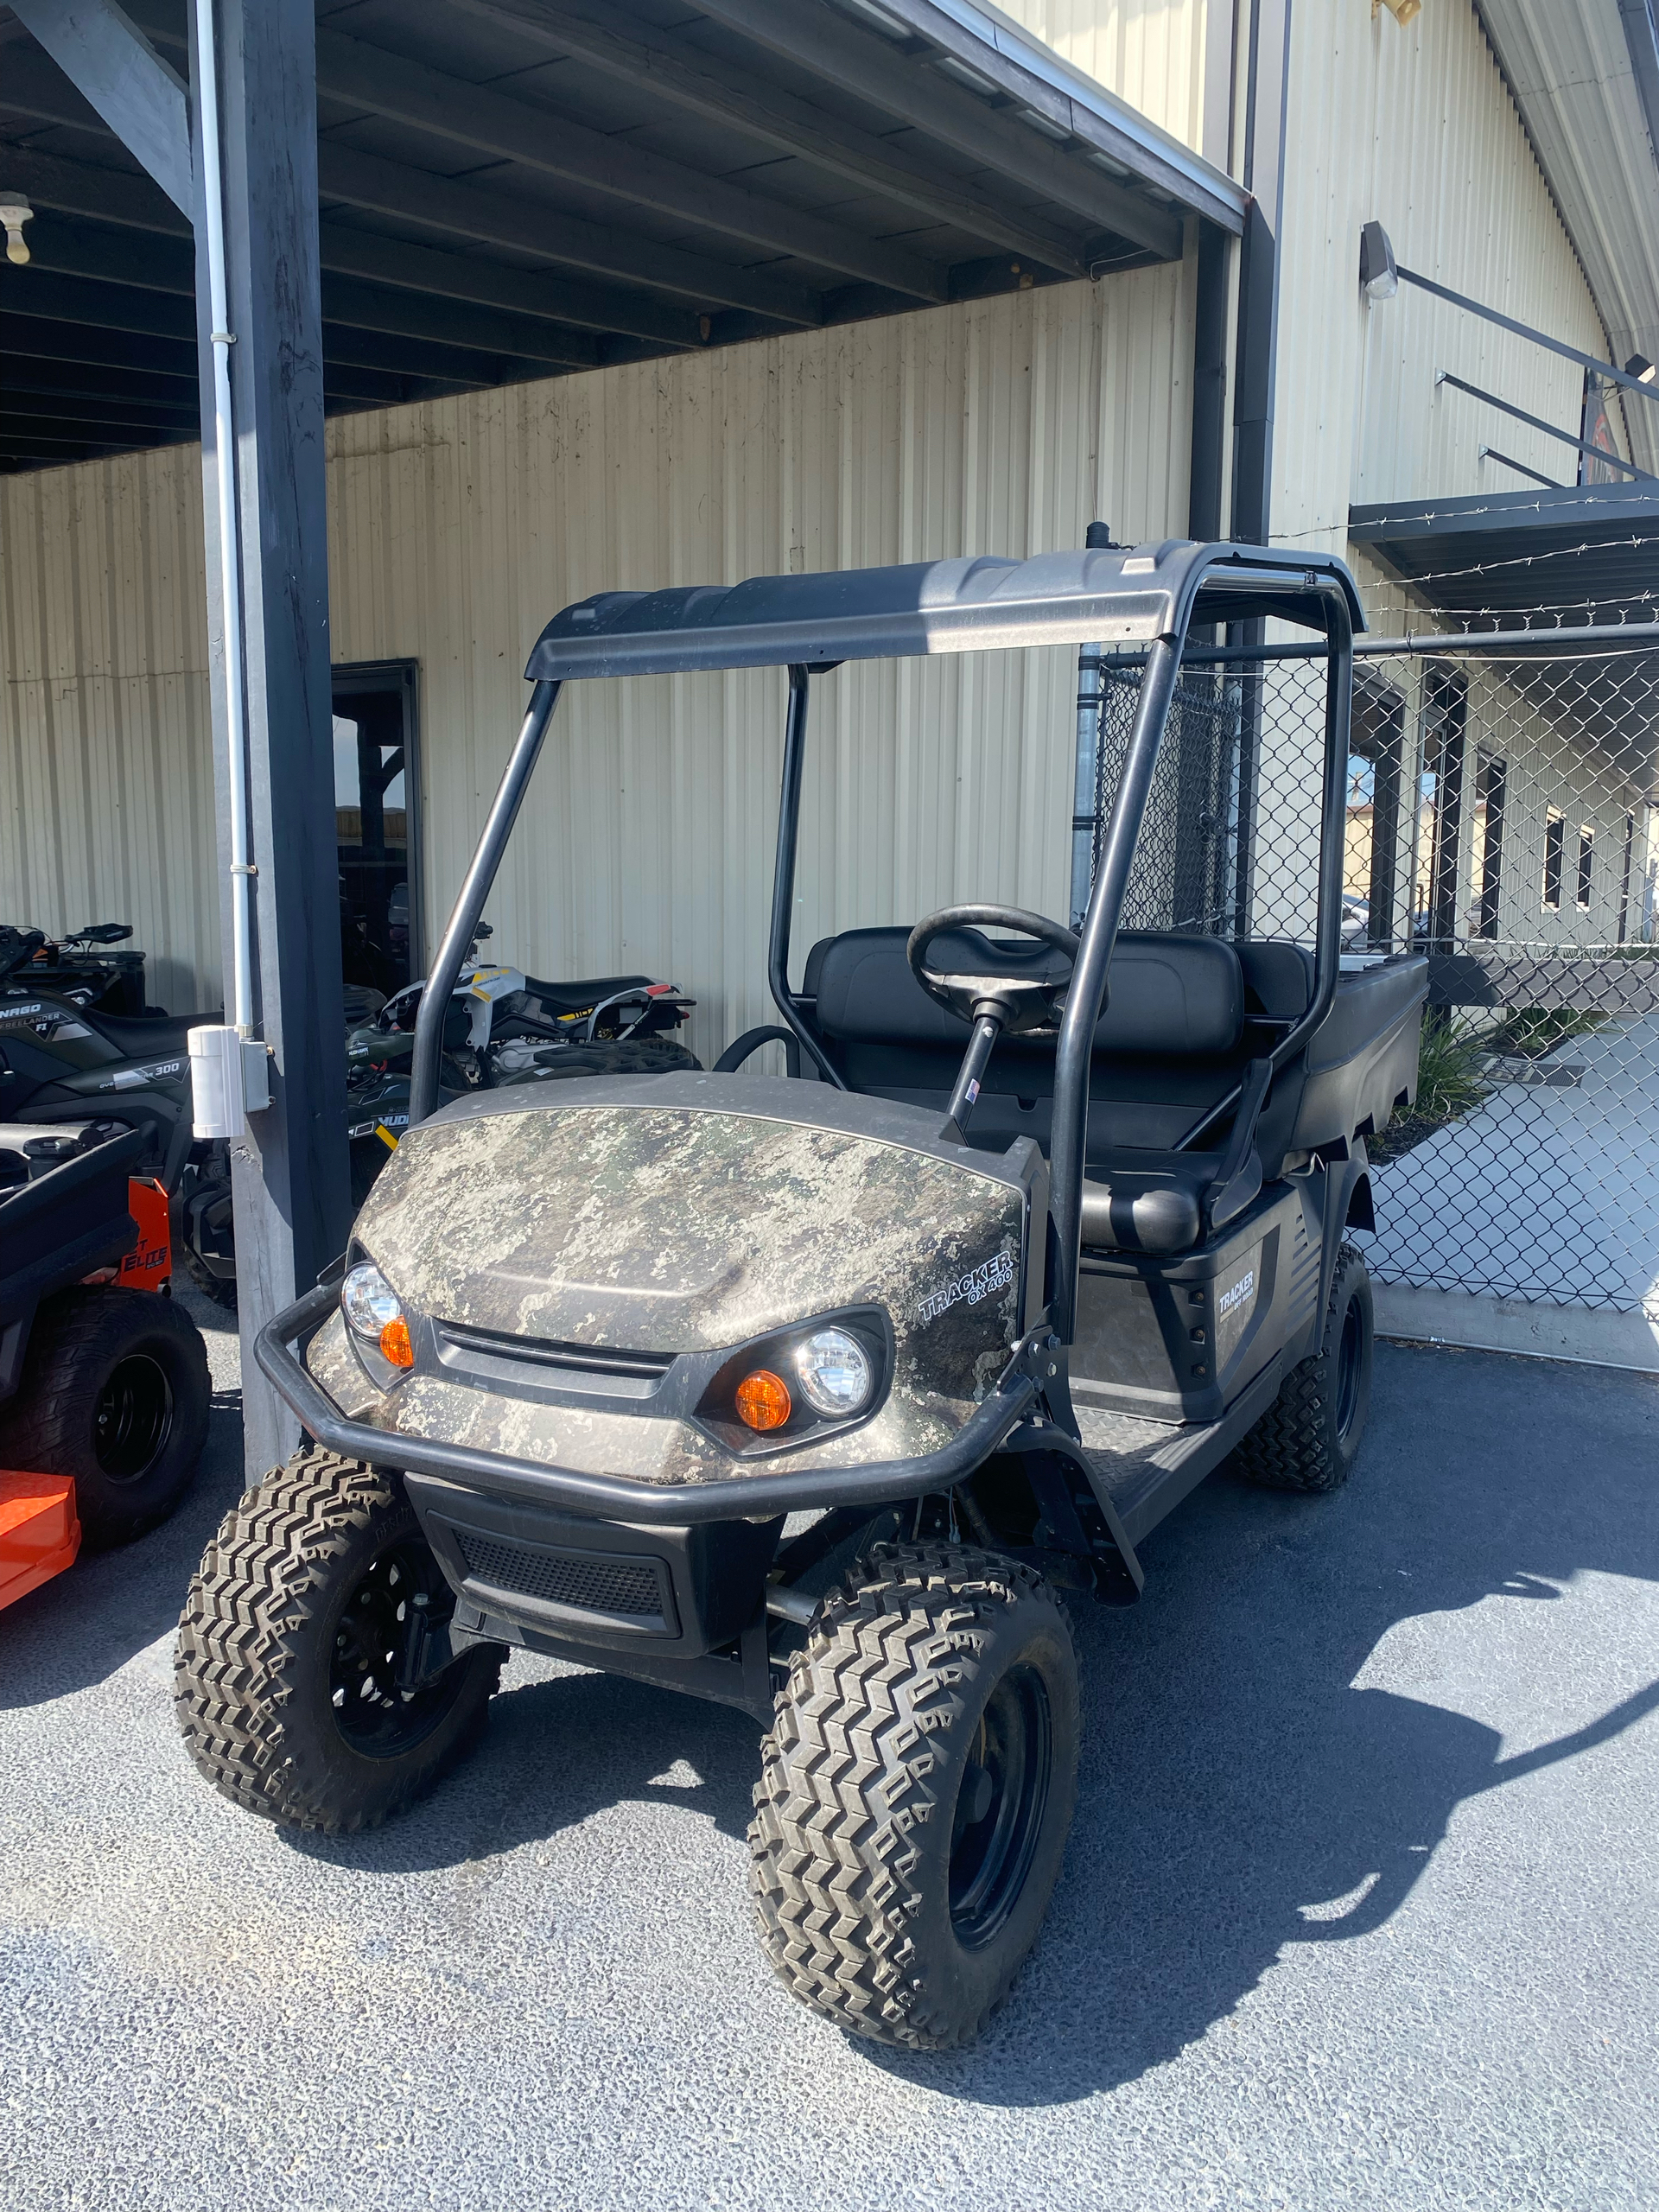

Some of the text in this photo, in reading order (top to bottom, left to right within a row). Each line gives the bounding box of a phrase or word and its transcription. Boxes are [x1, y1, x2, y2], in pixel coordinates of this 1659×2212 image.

[156, 1063, 180, 1076] 300
[378, 1115, 409, 1127] MUD
[124, 1246, 168, 1273] ELITE
[918, 1250, 1013, 1321] TRACKER
[968, 1268, 1013, 1305] OX 400
[1219, 1270, 1253, 1313] TRACKER
